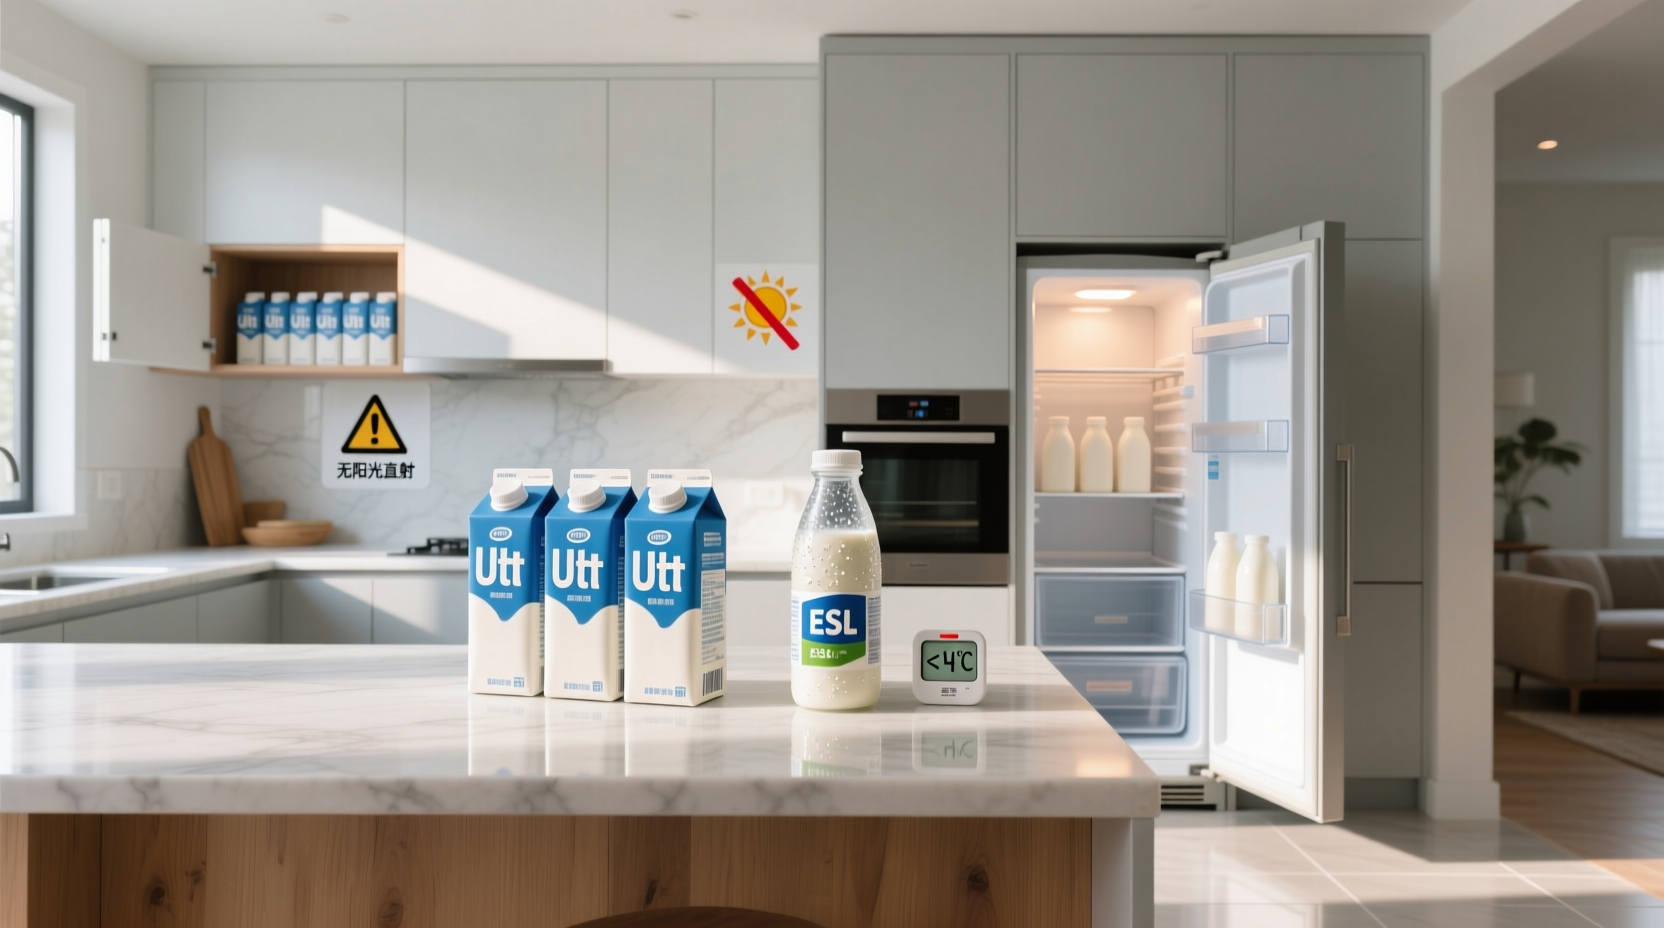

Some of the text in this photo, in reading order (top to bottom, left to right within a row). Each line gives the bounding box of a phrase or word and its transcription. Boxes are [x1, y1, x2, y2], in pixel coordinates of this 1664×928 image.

[337, 462, 415, 479] 无阳光直射
[475, 546, 525, 587] Utt
[552, 548, 604, 590] Utt
[632, 550, 686, 592] Utt
[809, 608, 858, 636] ESL
